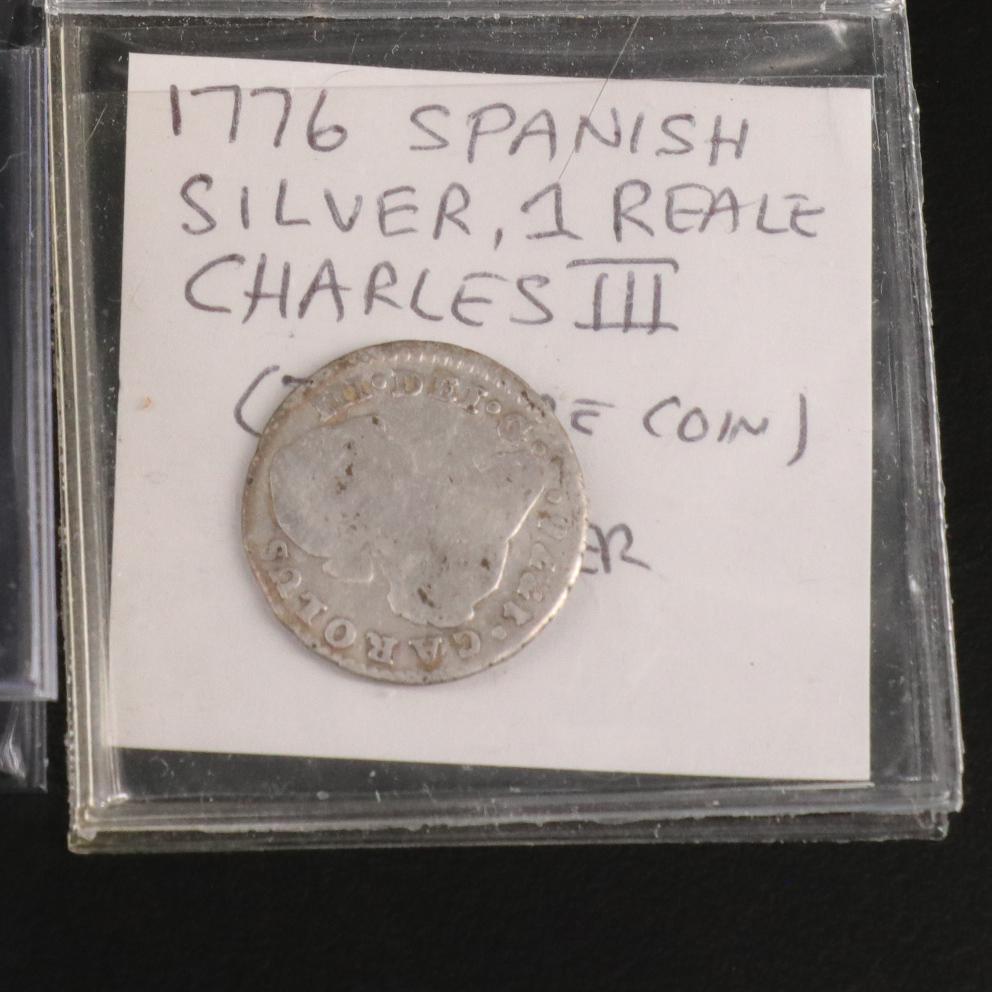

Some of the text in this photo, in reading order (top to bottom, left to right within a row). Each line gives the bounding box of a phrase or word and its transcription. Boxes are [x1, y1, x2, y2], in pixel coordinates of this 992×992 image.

[168, 80, 752, 168] 1776 SPANISH
[518, 180, 586, 242] 1
[612, 178, 825, 243] REALE
[182, 252, 680, 335] CHARLES III
